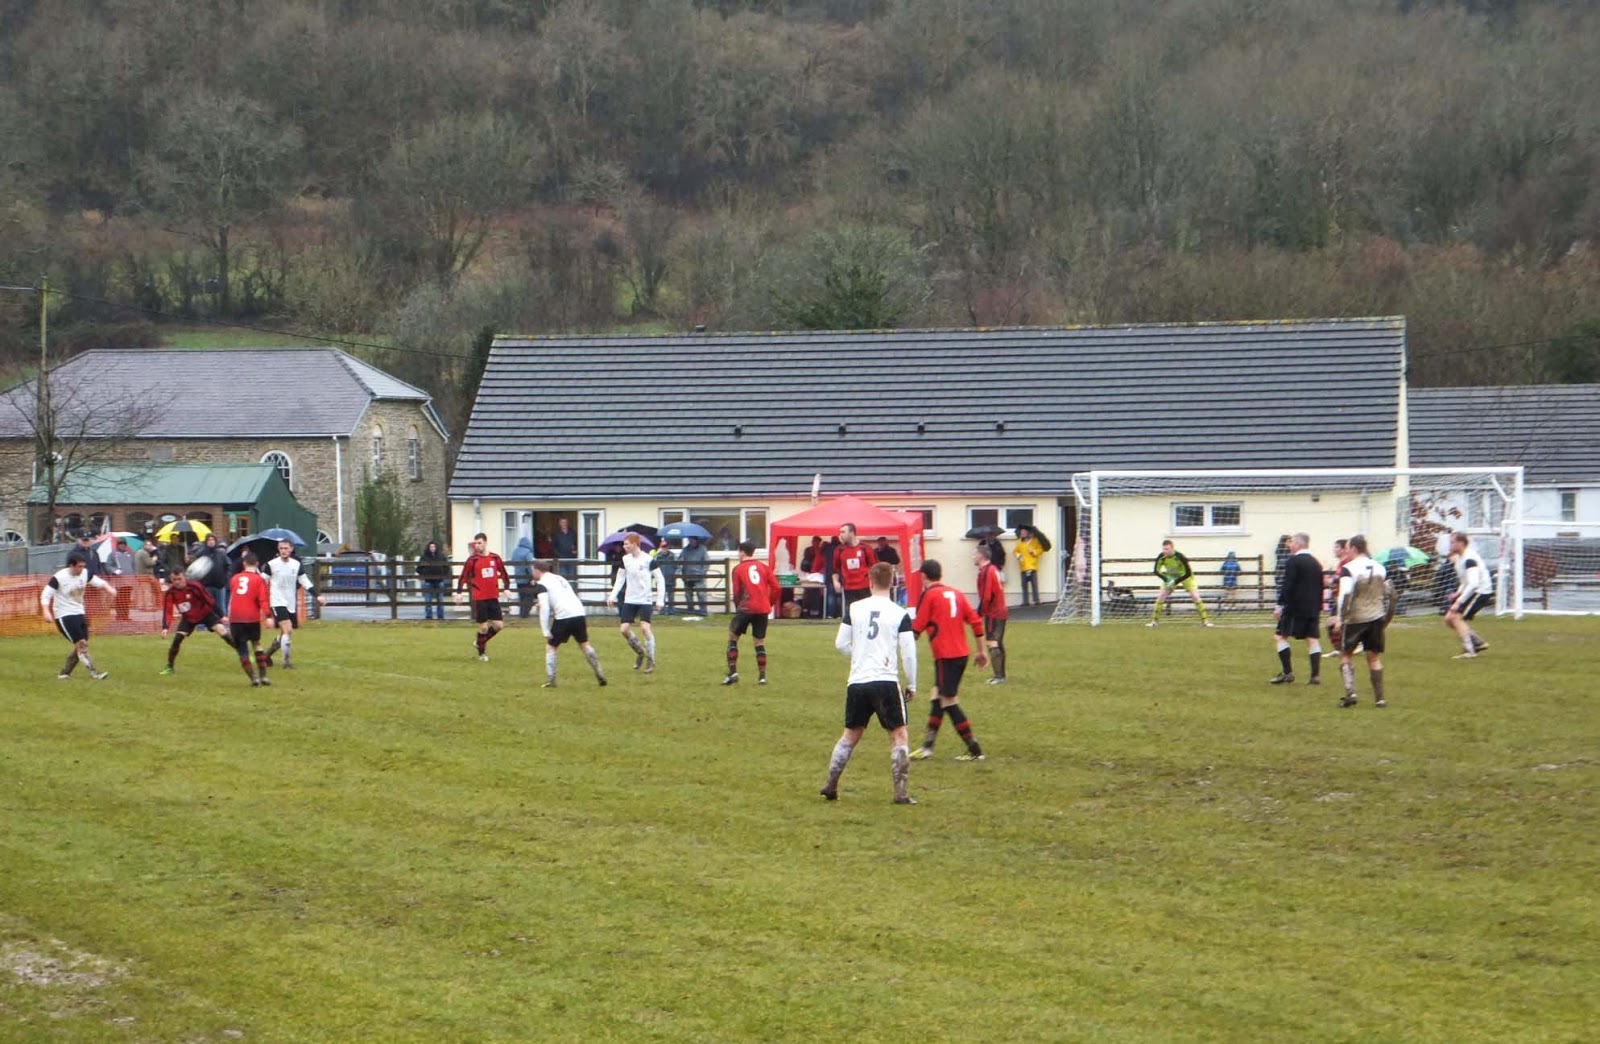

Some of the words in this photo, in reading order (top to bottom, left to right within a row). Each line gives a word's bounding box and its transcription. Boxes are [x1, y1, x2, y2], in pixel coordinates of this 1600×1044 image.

[236, 576, 249, 595] 3
[748, 564, 760, 585] 6
[942, 590, 957, 619] 7
[866, 610, 880, 640] 5
